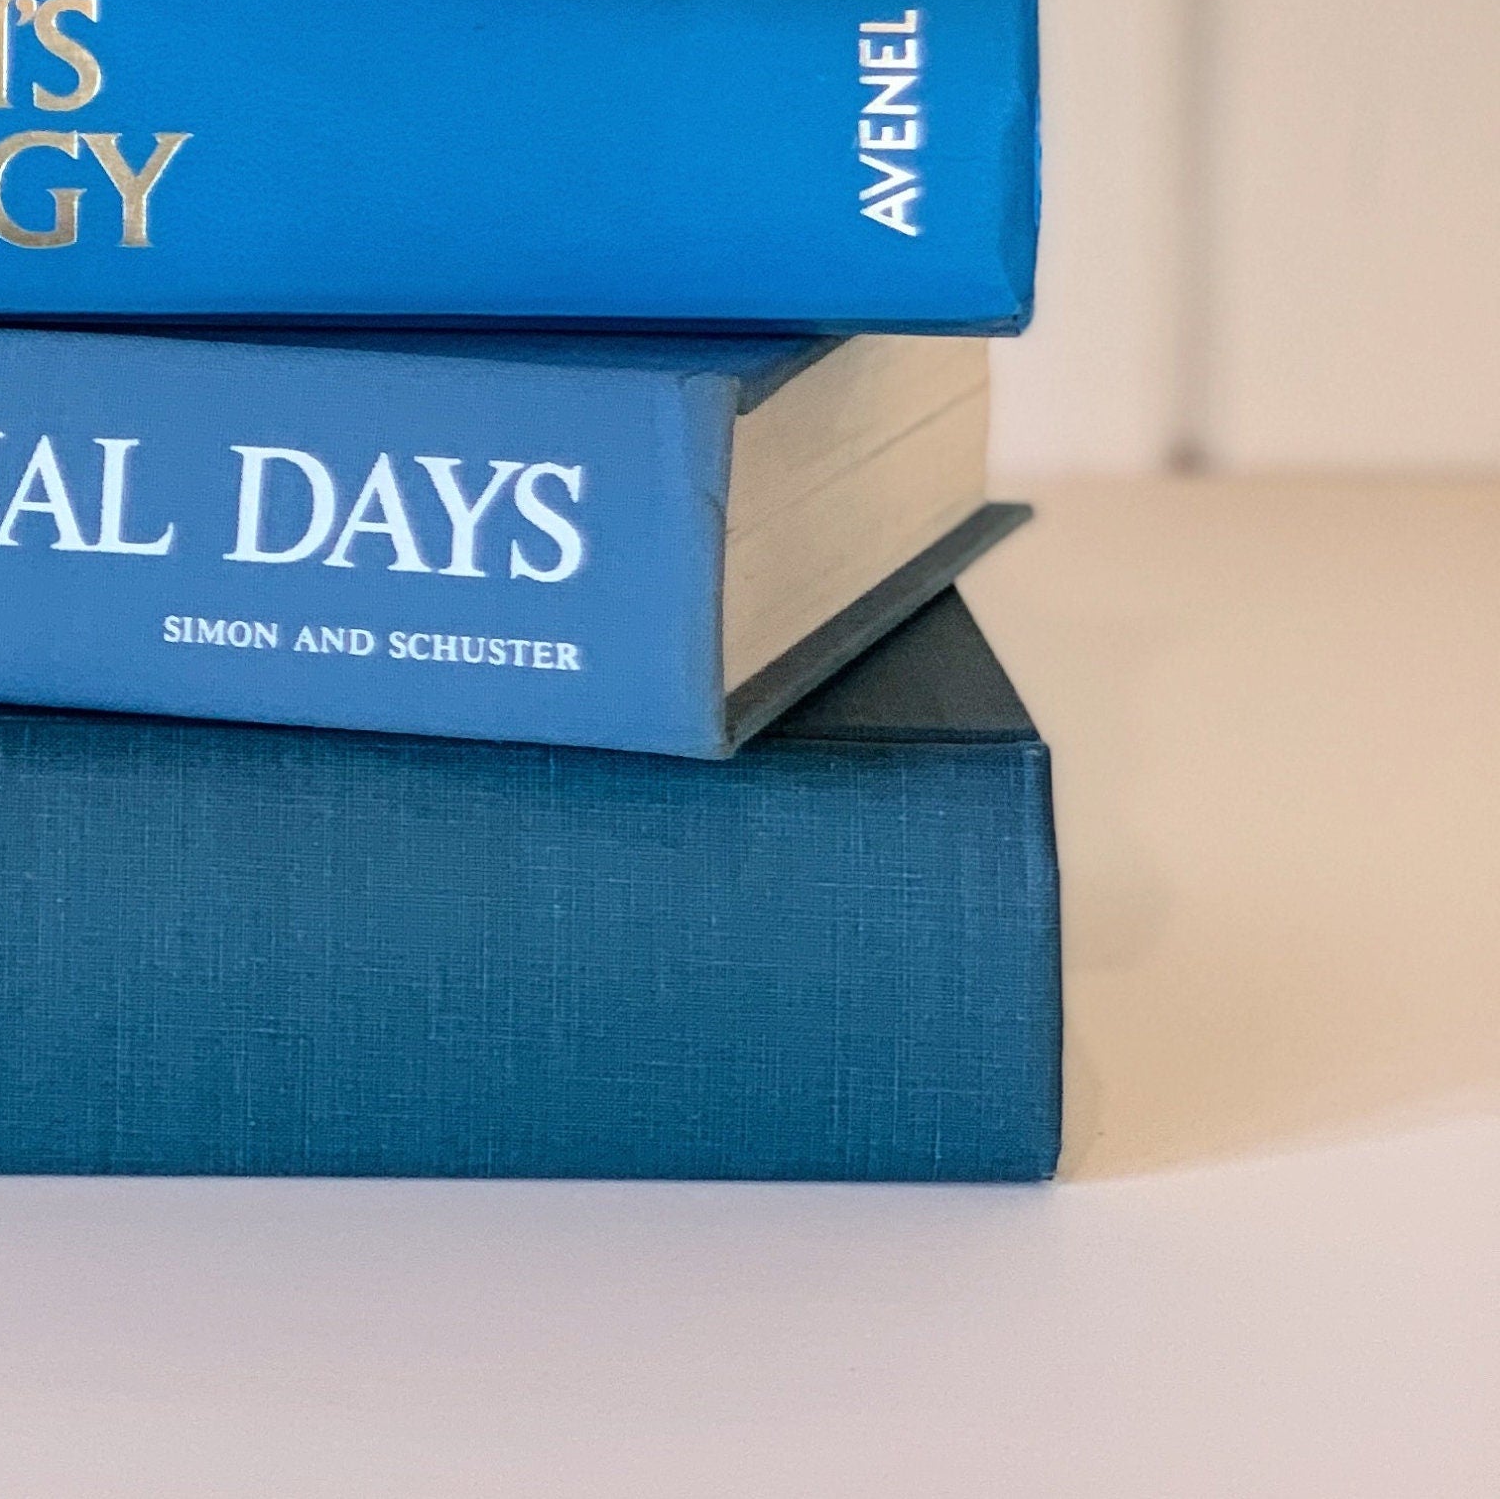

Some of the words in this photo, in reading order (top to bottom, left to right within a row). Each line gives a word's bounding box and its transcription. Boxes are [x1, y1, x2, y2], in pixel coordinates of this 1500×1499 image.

[858, 9, 918, 237] AVENEL
[223, 445, 583, 584] DAYS
[163, 615, 278, 651] SIMON
[295, 624, 374, 657] AND
[389, 630, 581, 672] SCHUSTER
